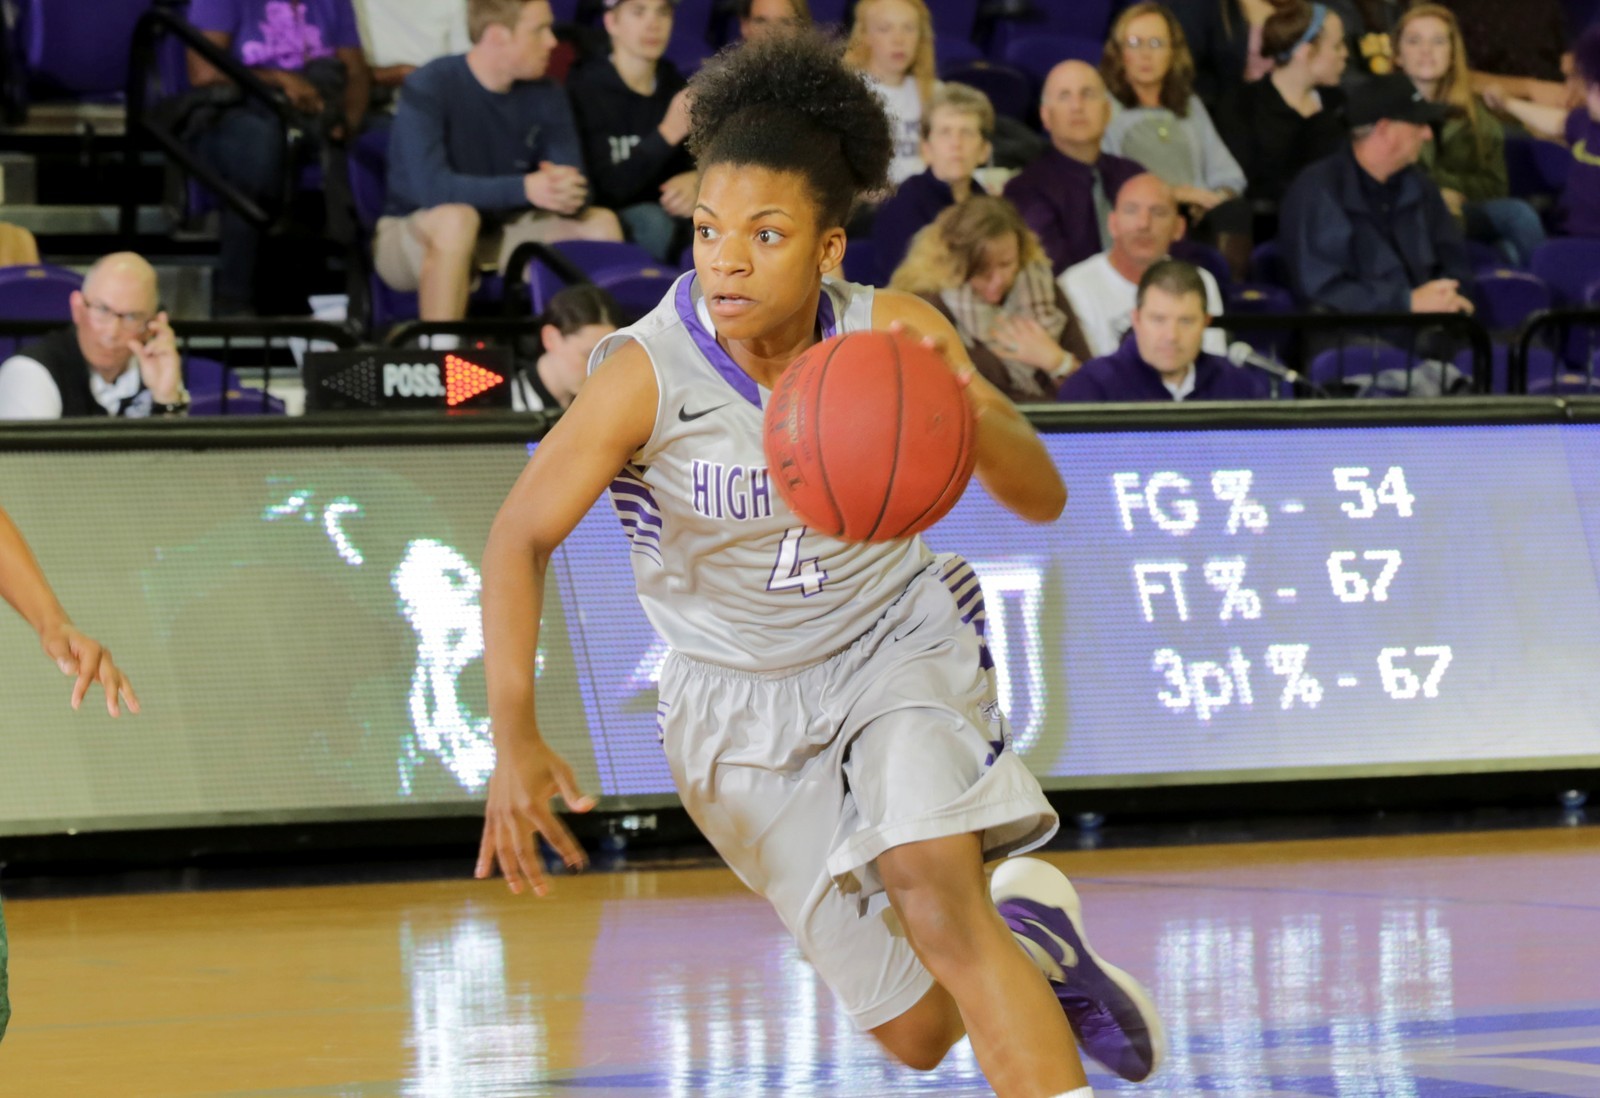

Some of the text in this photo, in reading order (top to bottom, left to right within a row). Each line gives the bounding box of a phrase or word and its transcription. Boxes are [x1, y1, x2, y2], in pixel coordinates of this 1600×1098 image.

[383, 363, 446, 397] POSS.
[691, 459, 773, 521] HIGH
[1112, 471, 1199, 534] FG
[1211, 470, 1268, 533] %
[1333, 466, 1415, 518] 54
[766, 525, 829, 598] 4
[1133, 561, 1188, 622] FT
[1204, 556, 1262, 623] %
[1326, 550, 1401, 602] 67
[1153, 647, 1253, 722] 3pt
[1264, 645, 1324, 709] %
[1377, 646, 1452, 698] 67
